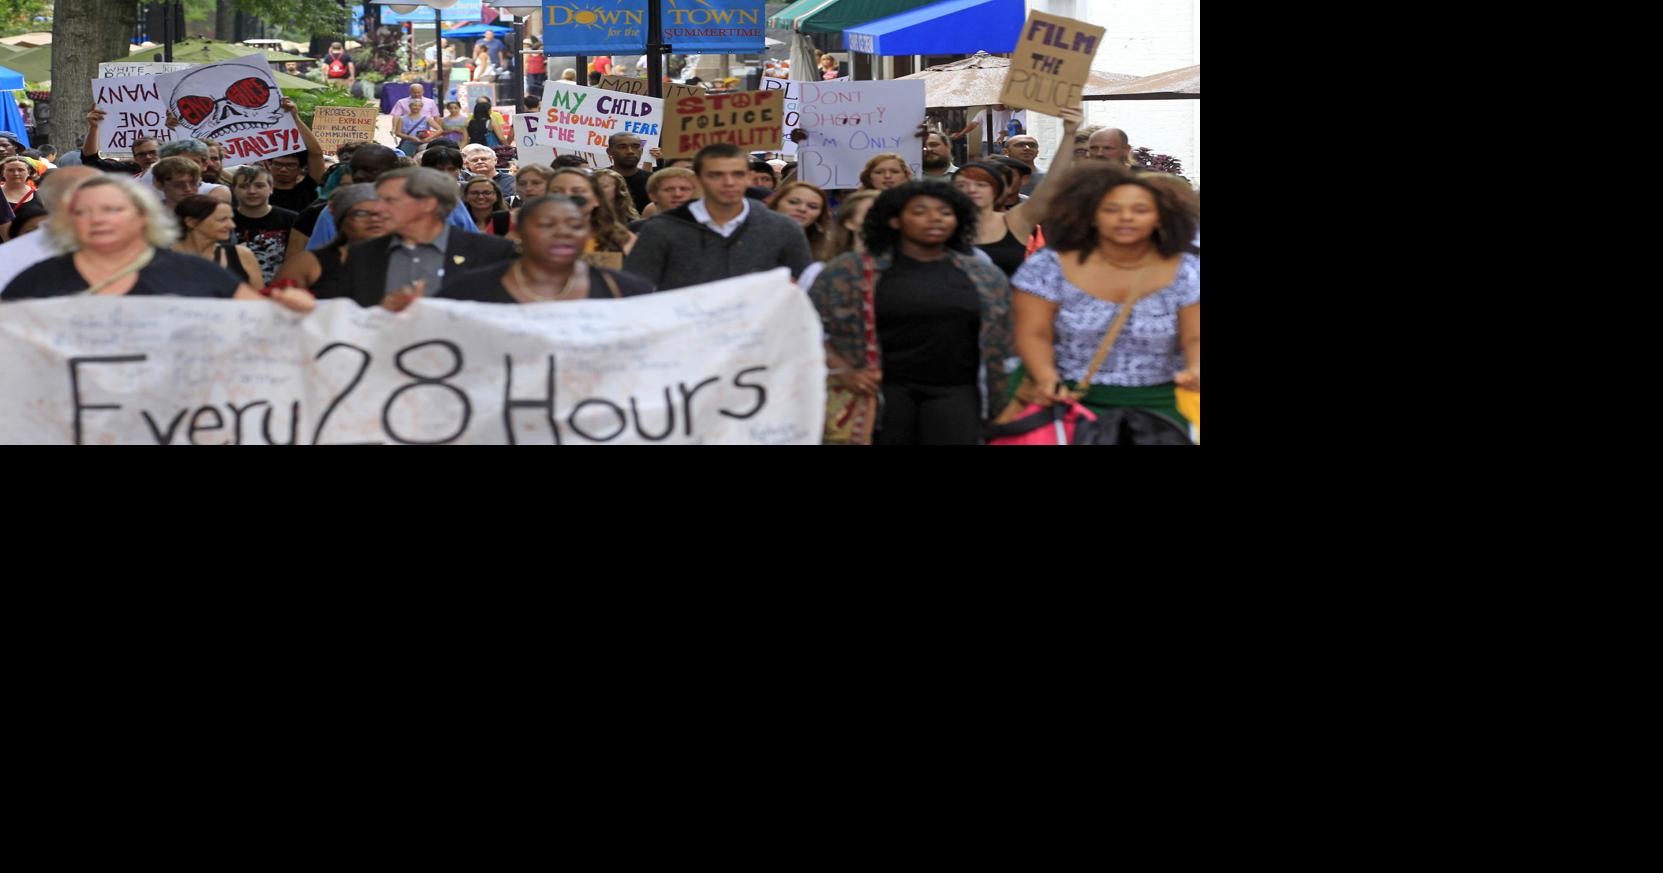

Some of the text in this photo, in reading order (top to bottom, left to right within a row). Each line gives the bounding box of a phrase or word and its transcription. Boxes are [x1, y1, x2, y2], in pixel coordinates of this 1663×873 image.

[667, 9, 760, 25] TOWN
[607, 28, 640, 39] for the
[664, 28, 761, 39] SUMMERTIME
[1026, 20, 1097, 56] FILM
[1031, 53, 1064, 75] THE
[97, 82, 160, 105] MANY
[1004, 68, 1082, 107] POLICE
[551, 90, 653, 117] MY CHILD
[676, 92, 773, 114] STOP
[331, 124, 357, 132] BLACK
[338, 117, 371, 125] EXPENSE
[624, 121, 659, 135] FEAR
[681, 109, 773, 131] POLICE
[222, 128, 300, 159] UTALITY!
[314, 131, 369, 139] COMMUNITIES
[544, 125, 576, 143] THE
[678, 126, 781, 153] BRUTALITY
[849, 130, 902, 150] ONLY
[313, 337, 472, 444] 28
[502, 353, 768, 444] Hours
